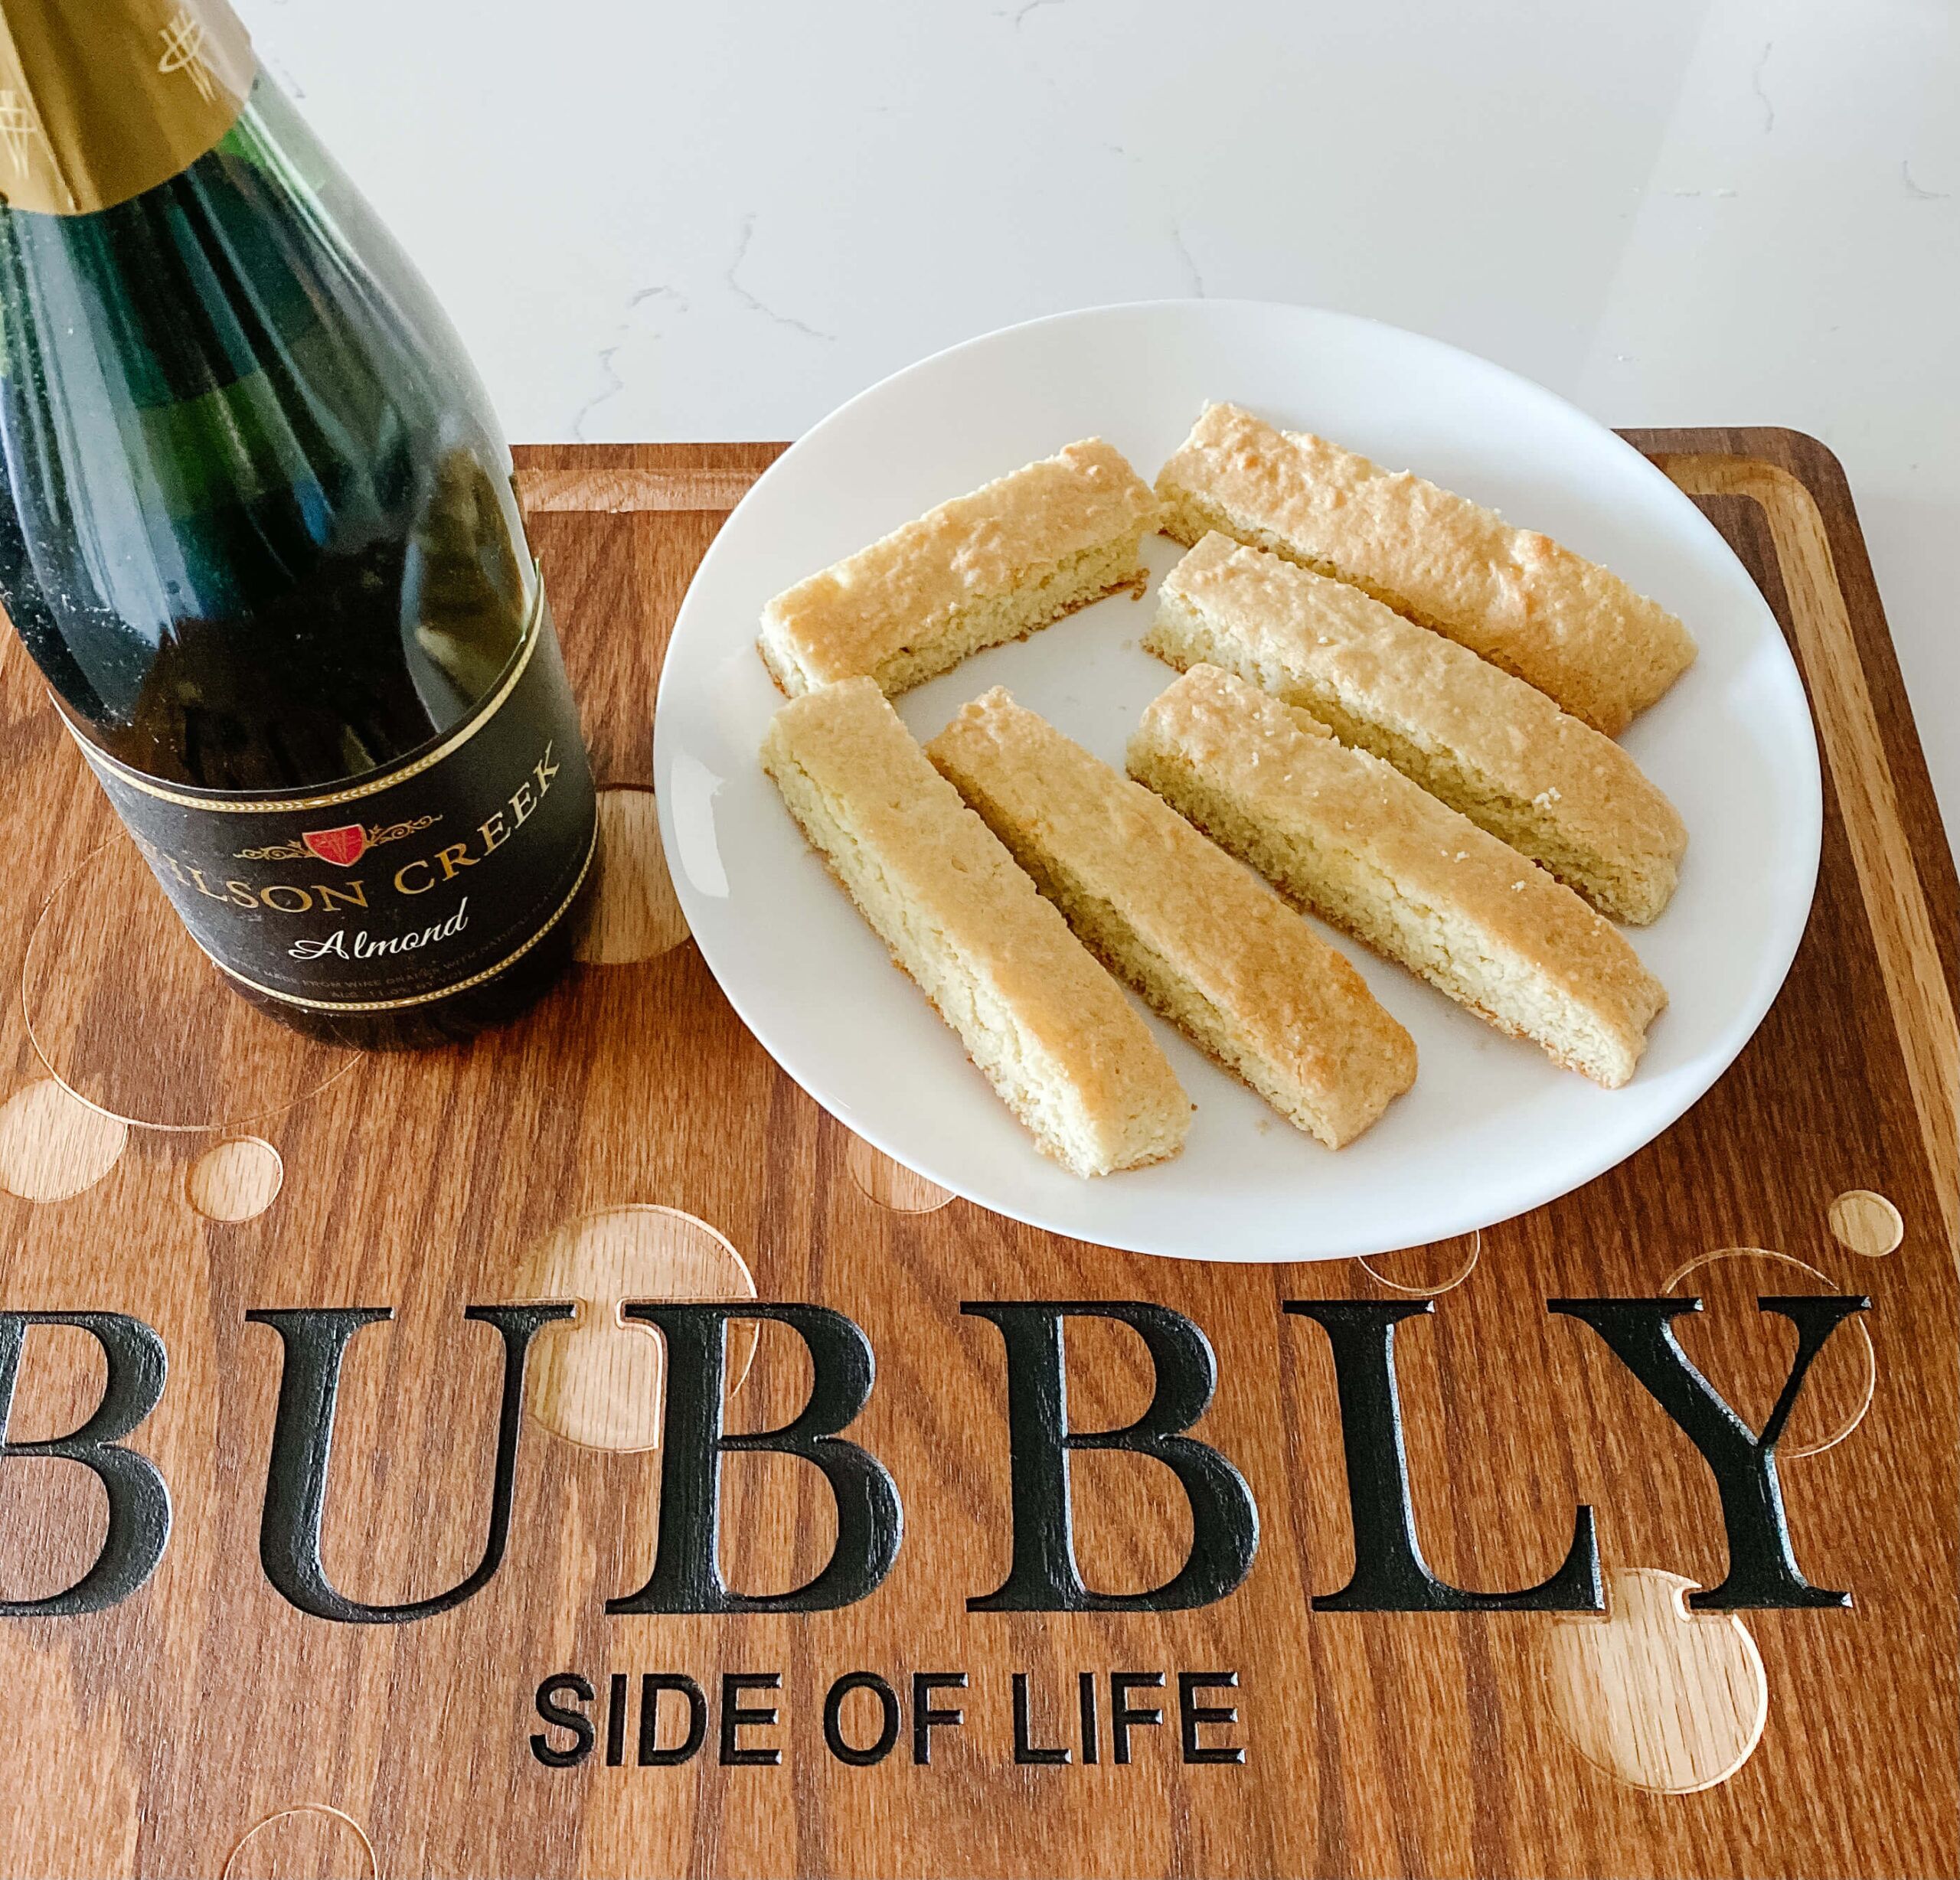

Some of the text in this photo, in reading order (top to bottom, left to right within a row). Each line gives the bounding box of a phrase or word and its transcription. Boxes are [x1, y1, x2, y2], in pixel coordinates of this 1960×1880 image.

[394, 739, 560, 894] CREEK
[288, 896, 469, 960] Almond
[0, 1295, 1872, 1624] BUBBLY
[530, 1671, 1246, 1768] SIDE OF LIFE
